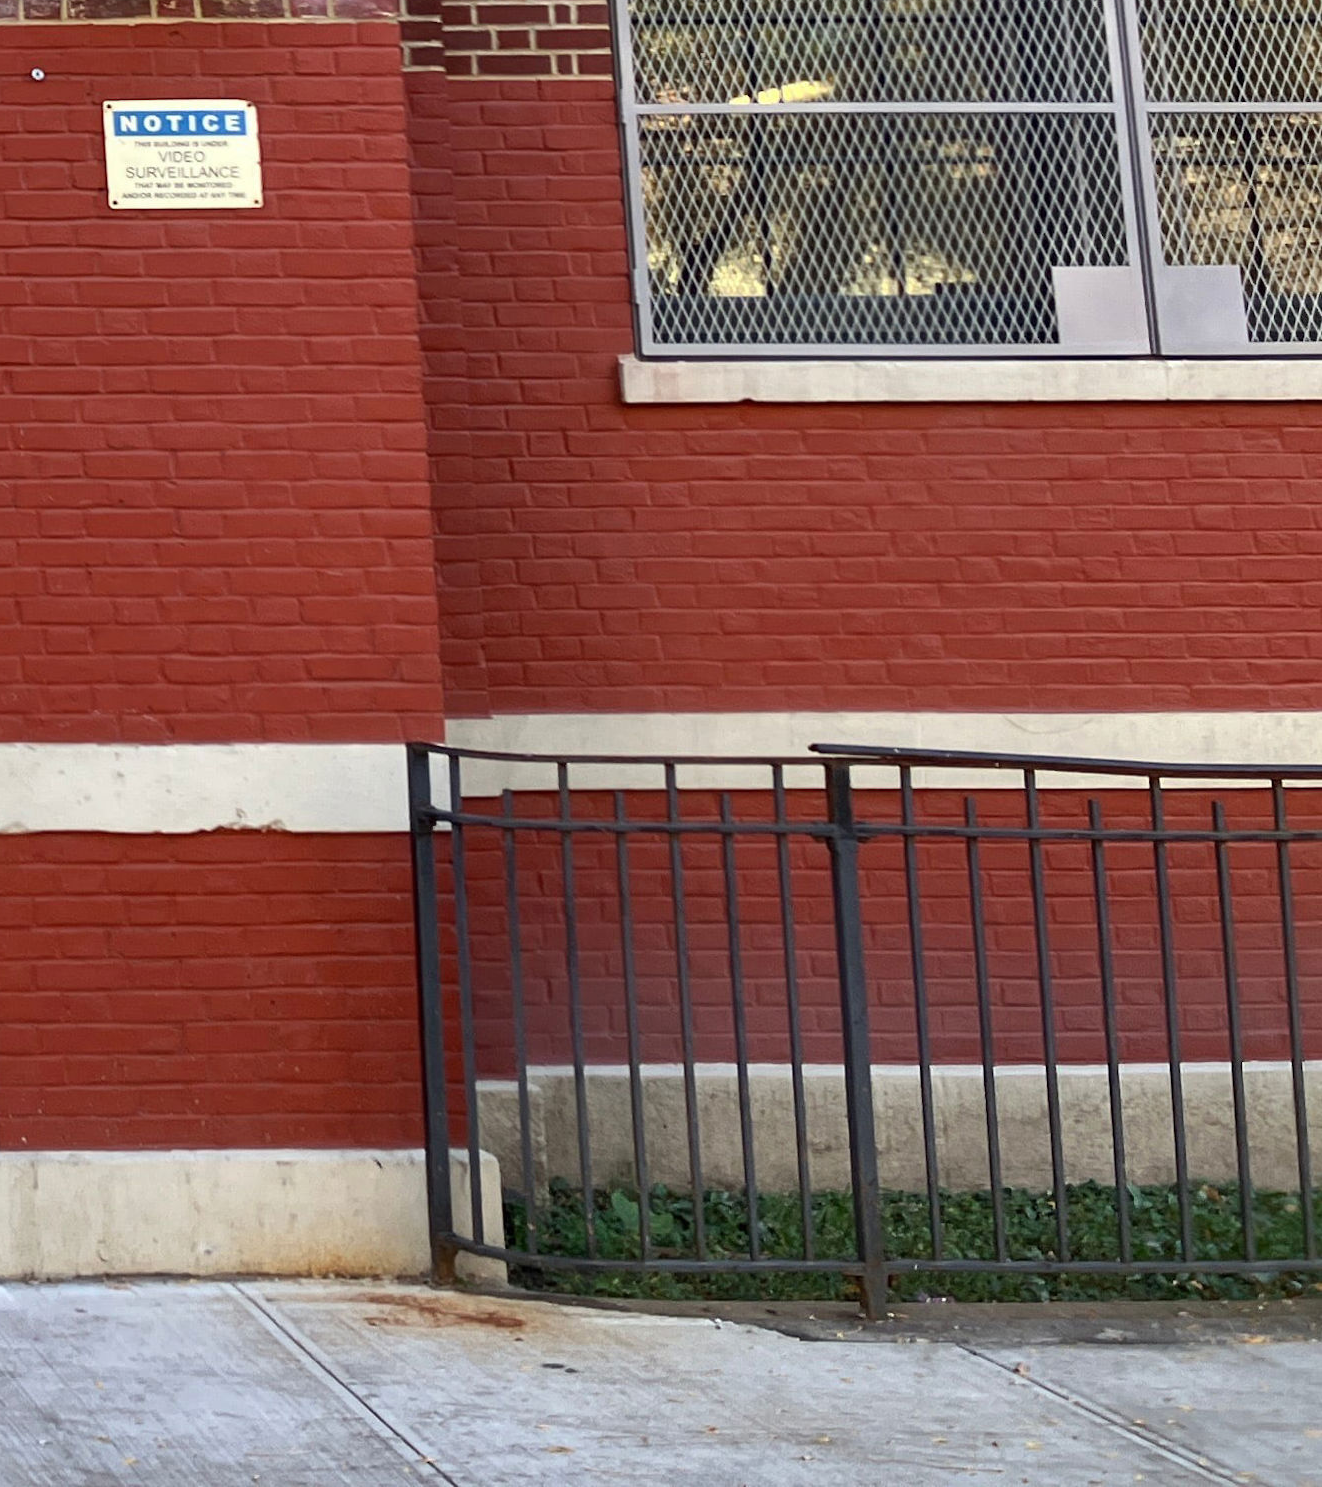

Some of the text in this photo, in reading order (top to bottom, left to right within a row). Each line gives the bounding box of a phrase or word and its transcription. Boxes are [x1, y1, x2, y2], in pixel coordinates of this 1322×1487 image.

[119, 113, 242, 133] NOTICE
[157, 151, 206, 162] VIDEO
[125, 166, 240, 179] SURVEILLANCE
